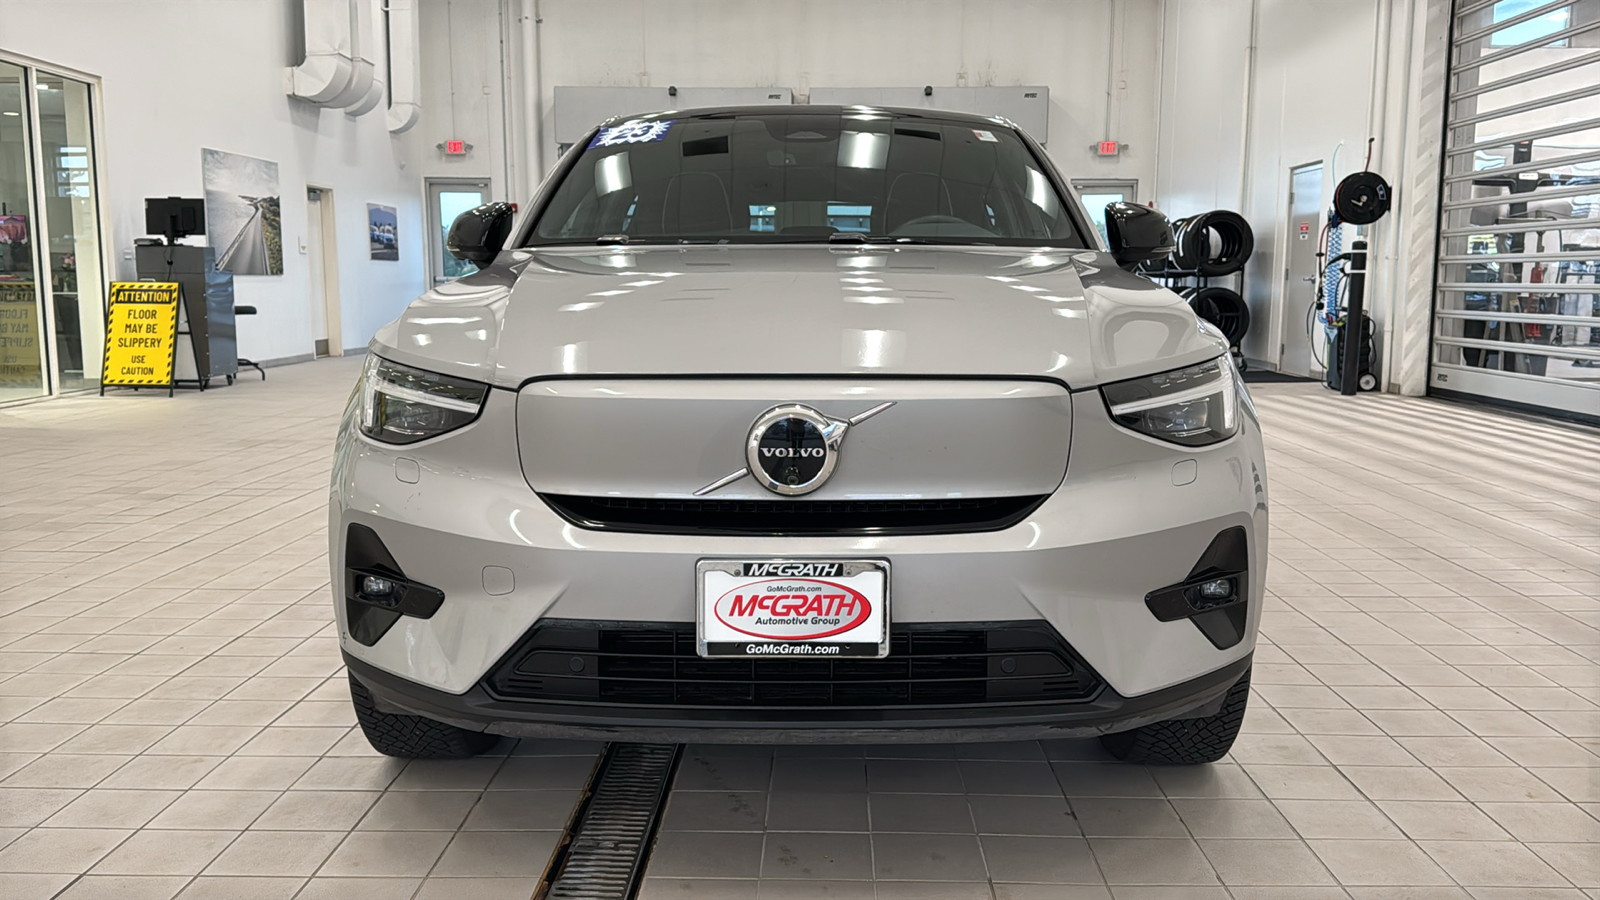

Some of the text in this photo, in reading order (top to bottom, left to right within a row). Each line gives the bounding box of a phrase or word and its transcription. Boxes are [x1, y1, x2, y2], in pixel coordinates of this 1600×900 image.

[609, 124, 655, 141] 23
[117, 291, 170, 302] ATTENTION
[127, 309, 157, 319] FLOOR
[124, 323, 158, 333] MAY BE
[118, 337, 162, 348] SLIPPERY
[131, 355, 146, 363] USE
[121, 366, 154, 375] CAUTION
[760, 447, 824, 458] VOLVO
[748, 563, 839, 576] McGRATH
[766, 585, 822, 593] GoMcGrath.com
[728, 594, 857, 617] McGRATH
[755, 616, 840, 626] Automotive Group
[746, 643, 840, 654] GoMcGrath.com
